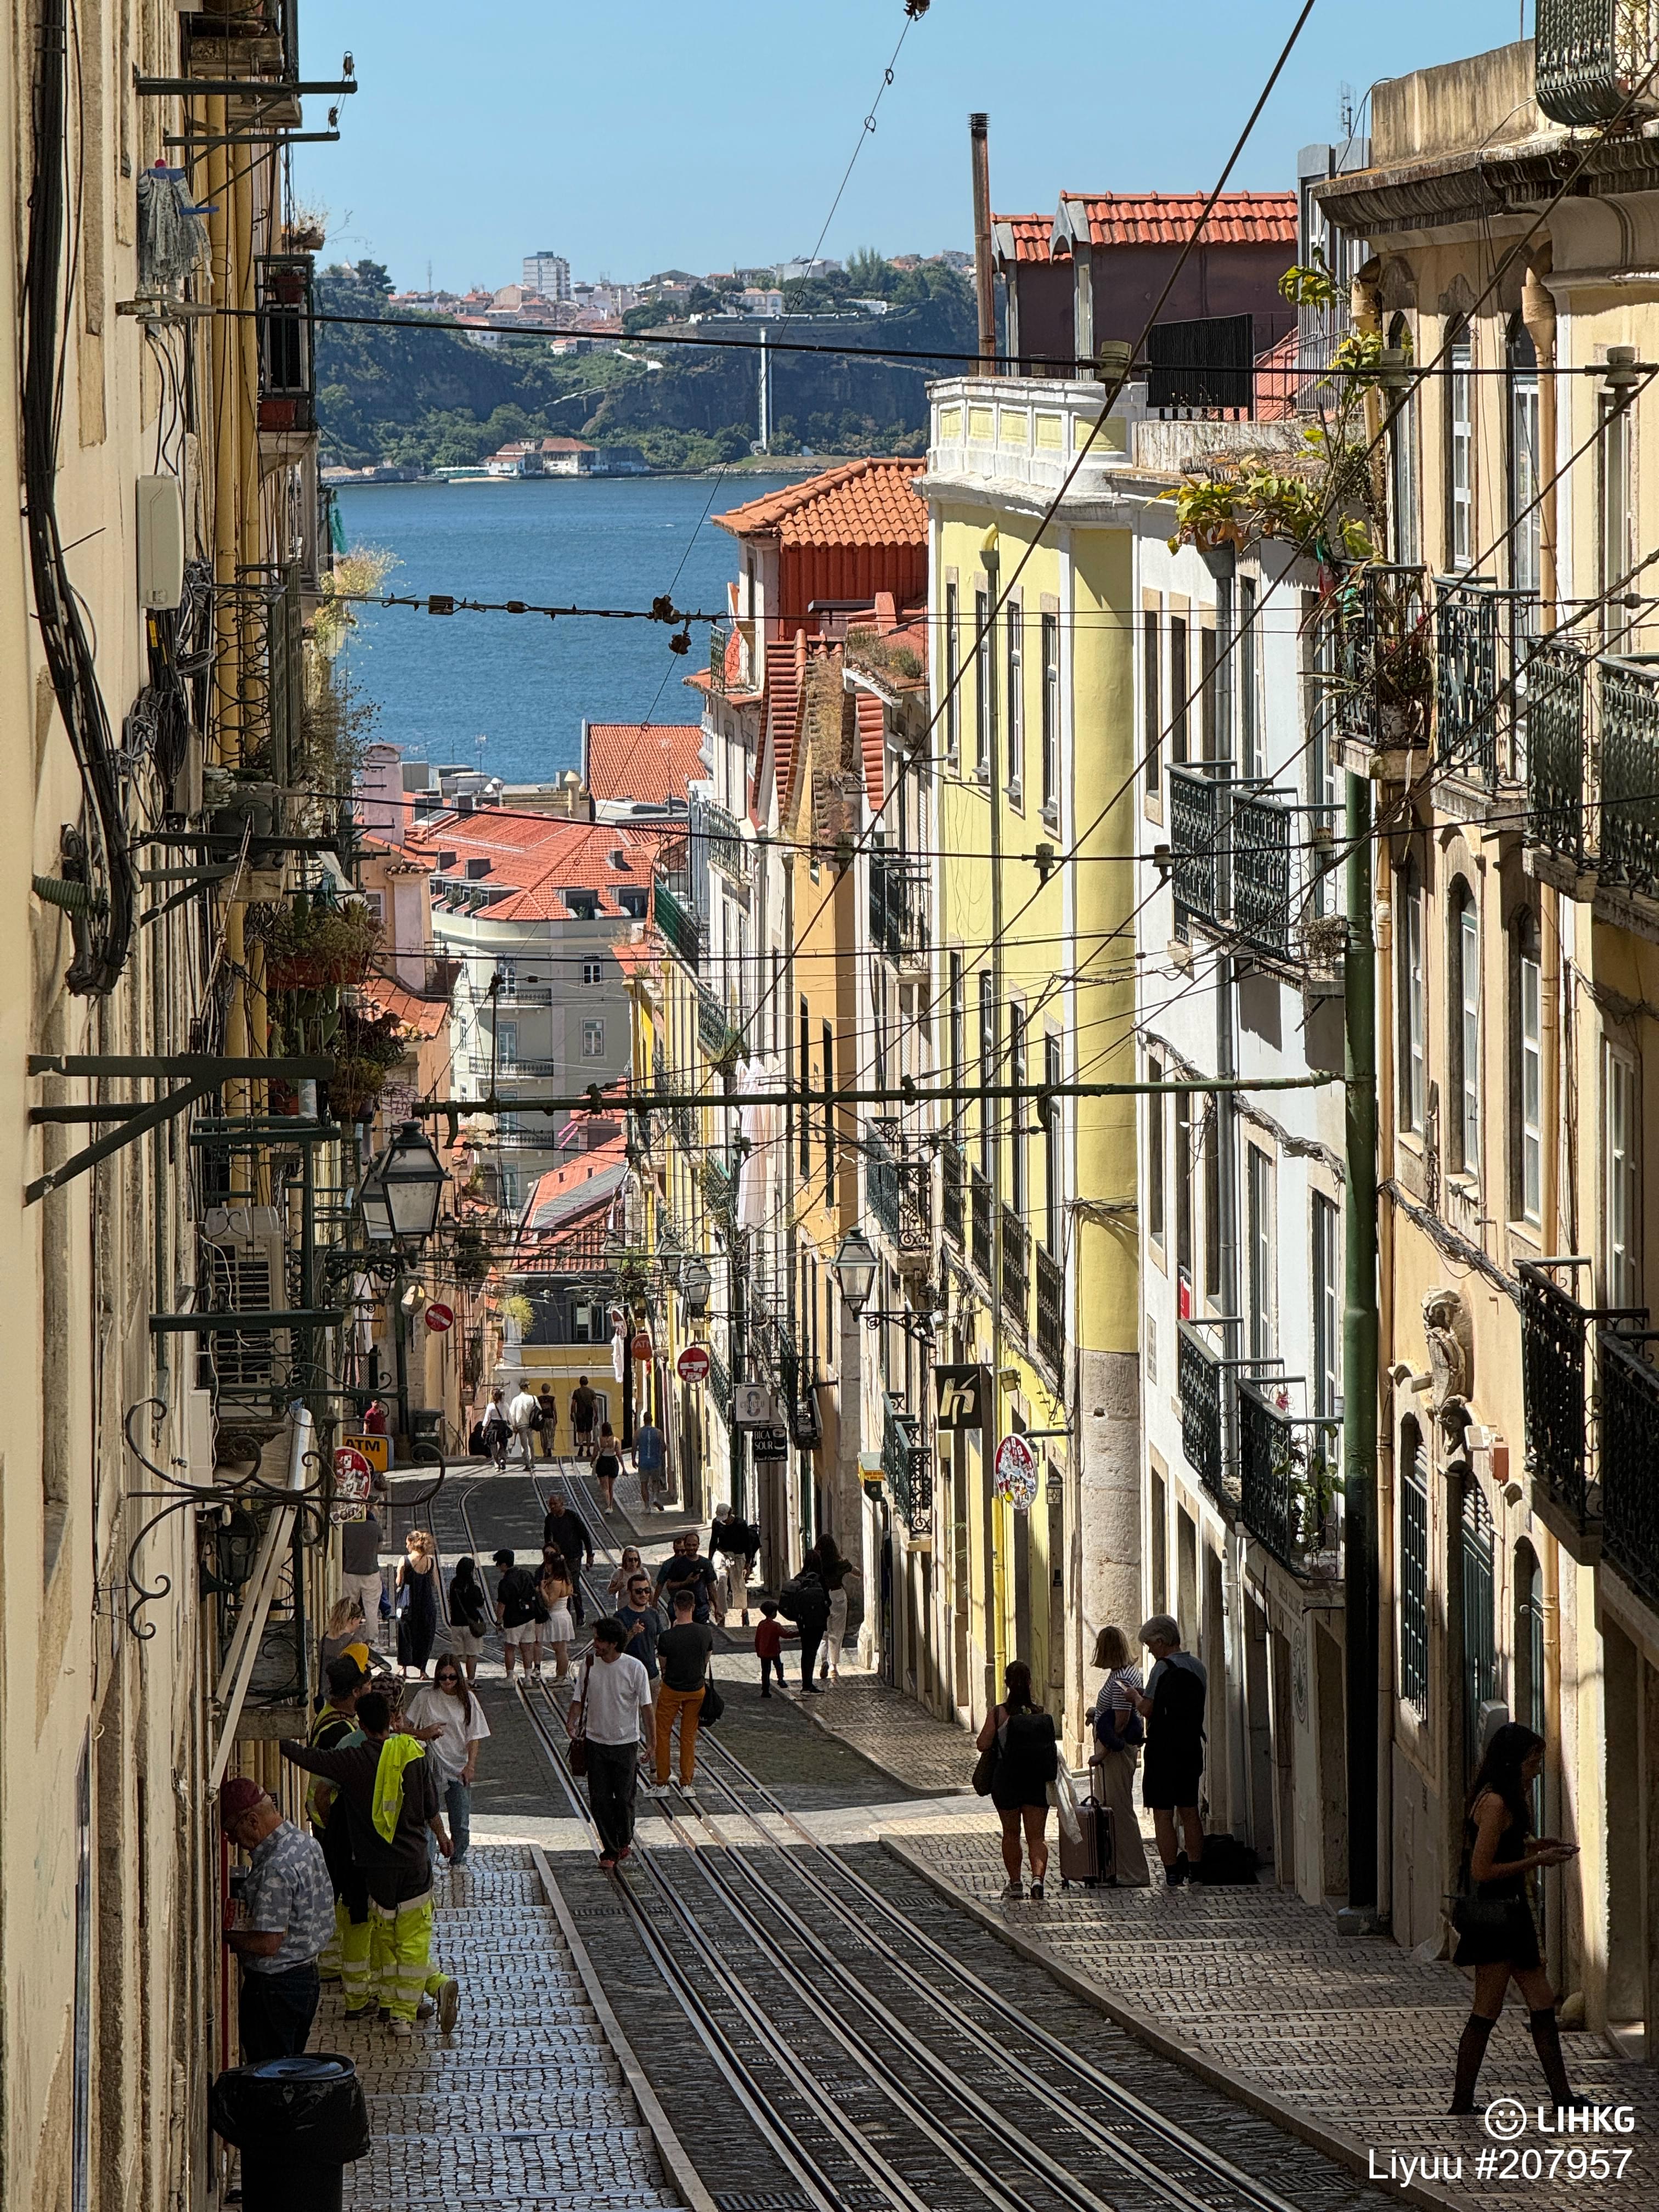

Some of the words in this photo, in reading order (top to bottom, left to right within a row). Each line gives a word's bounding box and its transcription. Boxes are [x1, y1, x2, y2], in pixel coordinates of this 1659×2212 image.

[754, 1430, 771, 1440] BICA
[345, 1438, 380, 1452] ATM
[754, 1440, 773, 1451] SOUR
